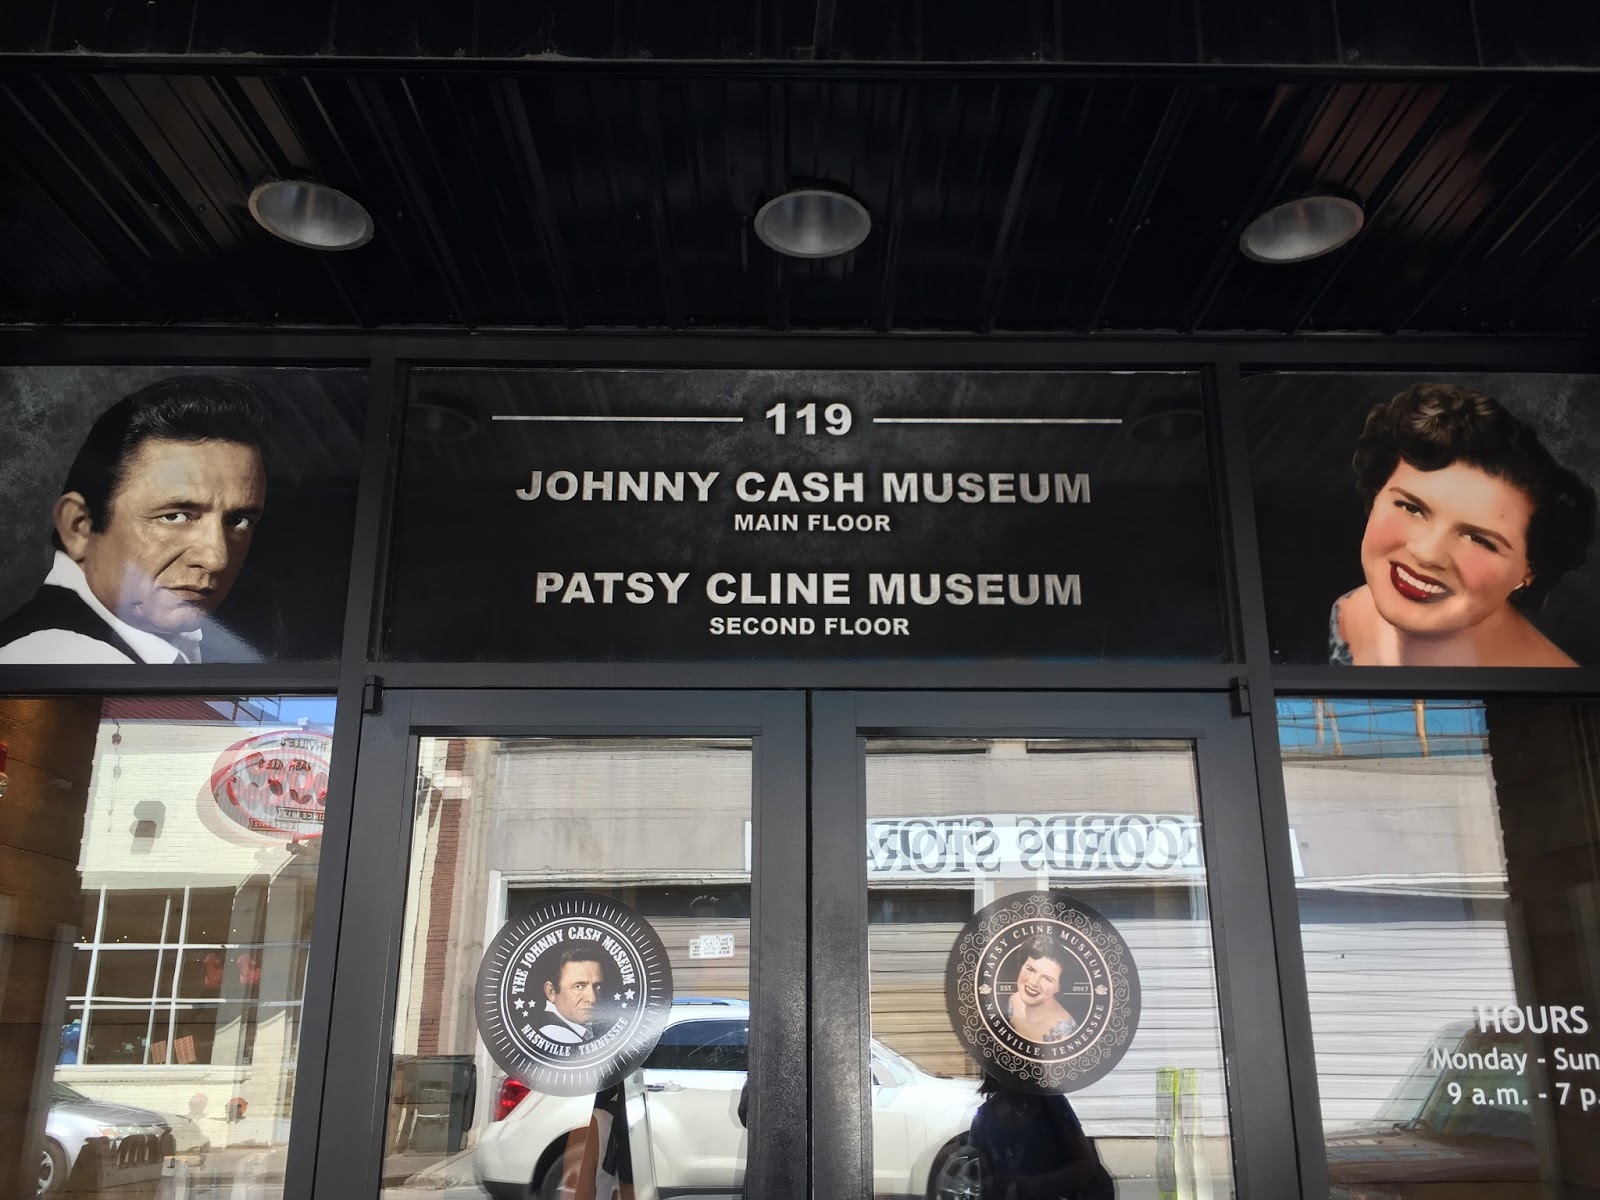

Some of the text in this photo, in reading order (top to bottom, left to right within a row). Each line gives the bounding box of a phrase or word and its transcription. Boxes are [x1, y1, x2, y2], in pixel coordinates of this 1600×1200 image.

[765, 403, 852, 436] 119
[515, 470, 1091, 504] JOHNNY CASH MUSEUM
[734, 513, 891, 532] MAIN FLOOR
[535, 572, 1082, 606] PATSY CLINE MUSEUM
[708, 616, 910, 636] SECOND FLOOR
[511, 926, 636, 995] THE JOHNNY CASH MUSEUM
[984, 925, 1103, 980] PATSY CLINE MUSEUM
[1051, 1003, 1105, 1056] TENNESSEE
[1478, 1005, 1588, 1034] HOURS
[520, 1017, 629, 1057] NASHVILLE TENNESSEE
[1432, 1046, 1528, 1076] Monday
[1447, 1082, 1462, 1106] 9
[1471, 1087, 1529, 1106] a.m.
[1555, 1082, 1571, 1106] 7
